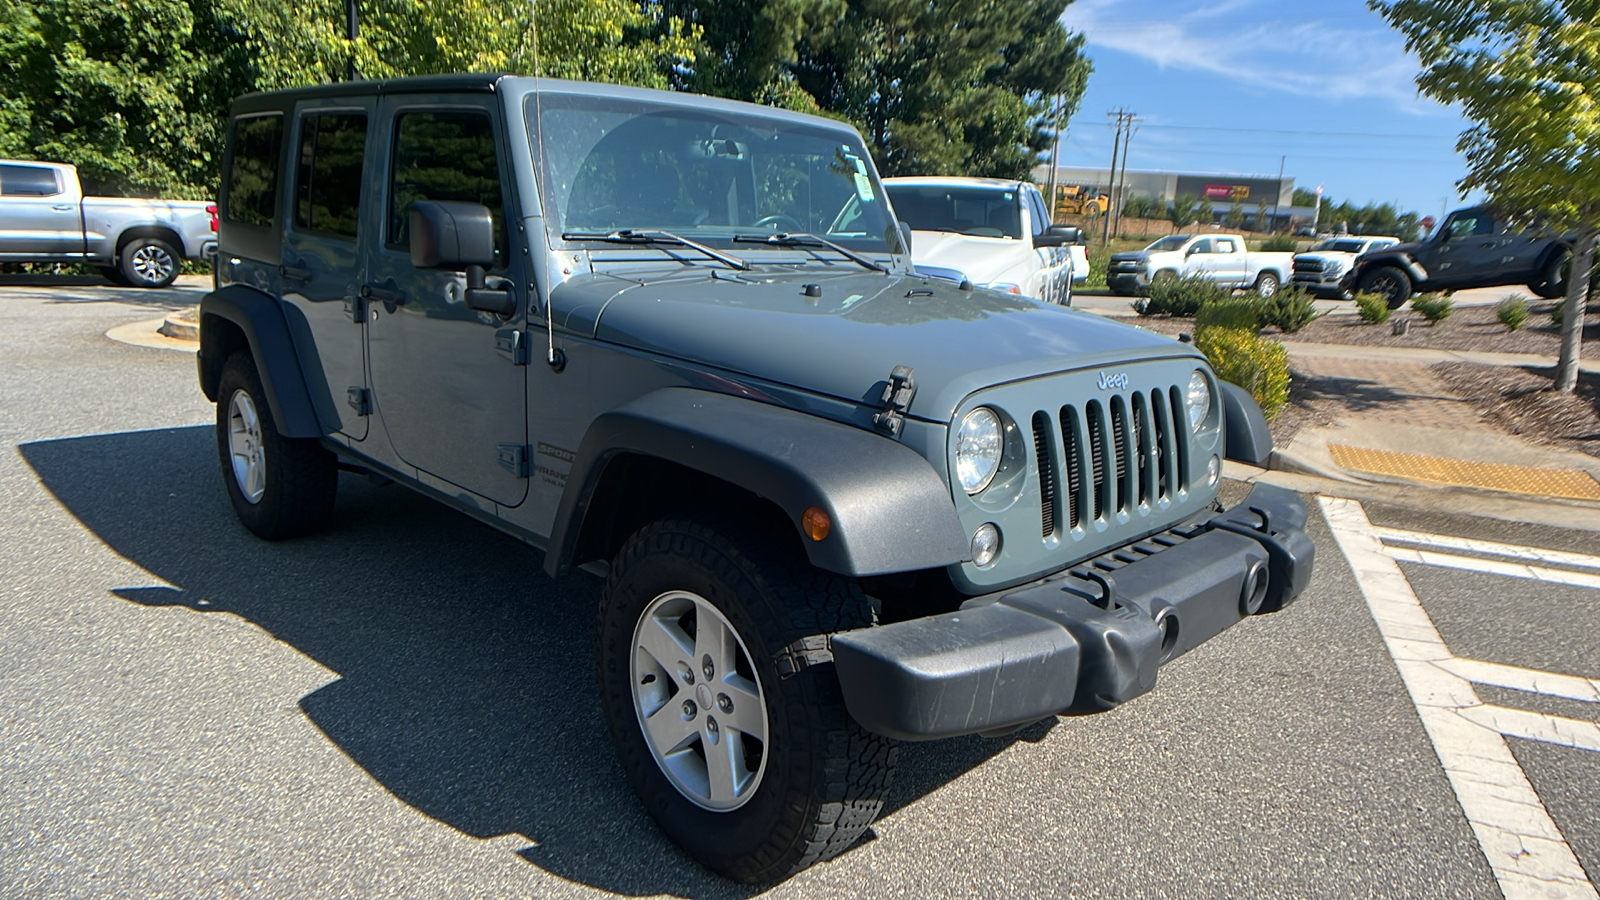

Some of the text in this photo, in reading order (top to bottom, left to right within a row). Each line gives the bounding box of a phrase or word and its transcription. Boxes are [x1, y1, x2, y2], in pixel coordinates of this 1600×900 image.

[1097, 370, 1129, 391] Jeep
[538, 443, 576, 461] SPORT
[535, 465, 569, 481] WRANG
